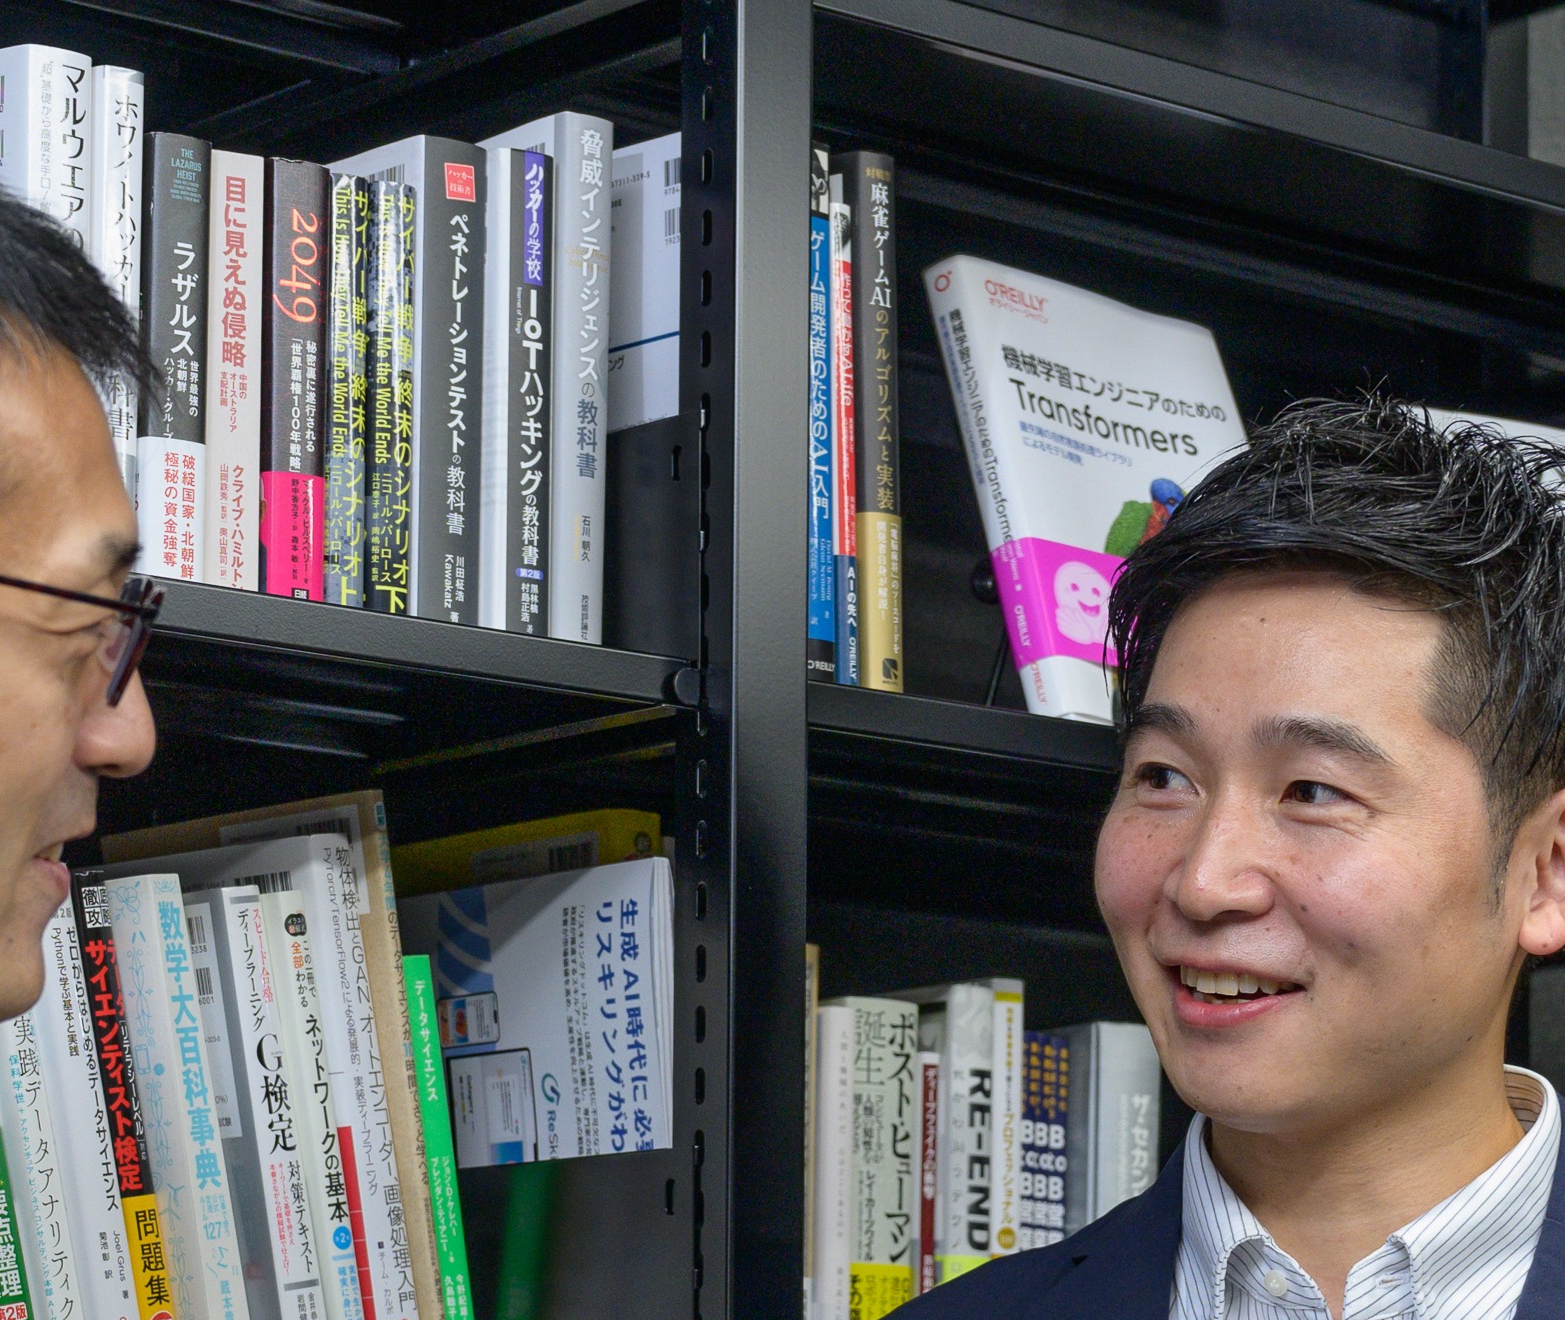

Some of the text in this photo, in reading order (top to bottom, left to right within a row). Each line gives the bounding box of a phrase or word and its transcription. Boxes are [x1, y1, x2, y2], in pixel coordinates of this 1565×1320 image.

[171, 157, 202, 172] LAZARUS
[176, 169, 197, 182] HEIST
[180, 148, 194, 160] THE
[221, 175, 248, 368] 目に見えぬ侵略
[273, 208, 319, 324] 2049
[524, 163, 545, 281] ハッカーの学校
[169, 241, 199, 357] ラザルス
[332, 187, 351, 458] This Tell Me the World Ends
[576, 129, 604, 480] 脅威インテリジェンスの教科書
[870, 182, 895, 512] 麻雀ゲームAIのアルゴリズムと実装
[984, 279, 1048, 312] O'REILLY
[176, 357, 187, 393] 北朝鮮
[189, 360, 200, 418] 世界最強の
[220, 371, 229, 407] 支配計画
[229, 372, 238, 433] オーストラリア
[238, 373, 248, 400] 中国の
[305, 340, 318, 453] 秘密裏に遂行される
[343, 191, 370, 578] サイバー戦争 終末のシナリオ
[374, 338, 392, 465] Me the World Ends
[375, 197, 415, 614] サイバー戦争 終末のシナリオ 下
[446, 213, 472, 537] ペネトレーションテストの教科書
[517, 289, 545, 567] IoTハッキングの教科書
[810, 231, 829, 520] ゲーム開発者のためのAI入門
[1001, 344, 1227, 422] 機械学習エンジニアのための
[1008, 378, 1199, 457] Transformers
[163, 451, 180, 568] 極秘の資金強奪
[180, 454, 196, 580] 破綻国家・北朝鮮
[581, 515, 592, 538] 石川
[444, 554, 454, 608] Kawakatz
[519, 568, 542, 580] 第2版
[846, 566, 857, 628] AIの先へ
[848, 637, 858, 681] O'REILLY
[51, 926, 80, 1057] Pythonで学ぶ基本と実践
[237, 908, 266, 1032] ディープラーニング
[290, 940, 309, 1008] 全部わかる
[303, 939, 317, 998] この一冊で
[596, 900, 628, 1152] リスキリングがわ
[8, 1054, 26, 1104] 保科学世
[66, 925, 119, 1212] ゼロからはじめるデータサイエンス
[85, 939, 144, 1192] サイエンティスト検定
[157, 900, 222, 1191] 数学大百科事典
[256, 1033, 298, 1156] G検定
[414, 979, 438, 1101] データサイエンス
[853, 1009, 886, 1087] 誕生
[305, 1013, 350, 1224] ネットワークの基本
[885, 1012, 915, 1264] ポスト・ヒューマン
[967, 1067, 992, 1252] RE-END
[98, 1232, 109, 1251] 菊池
[112, 1230, 127, 1282] Joel Grus
[135, 1208, 171, 1307] 問題集
[202, 1221, 222, 1241] 127
[286, 1160, 313, 1275] 対策テキスト
